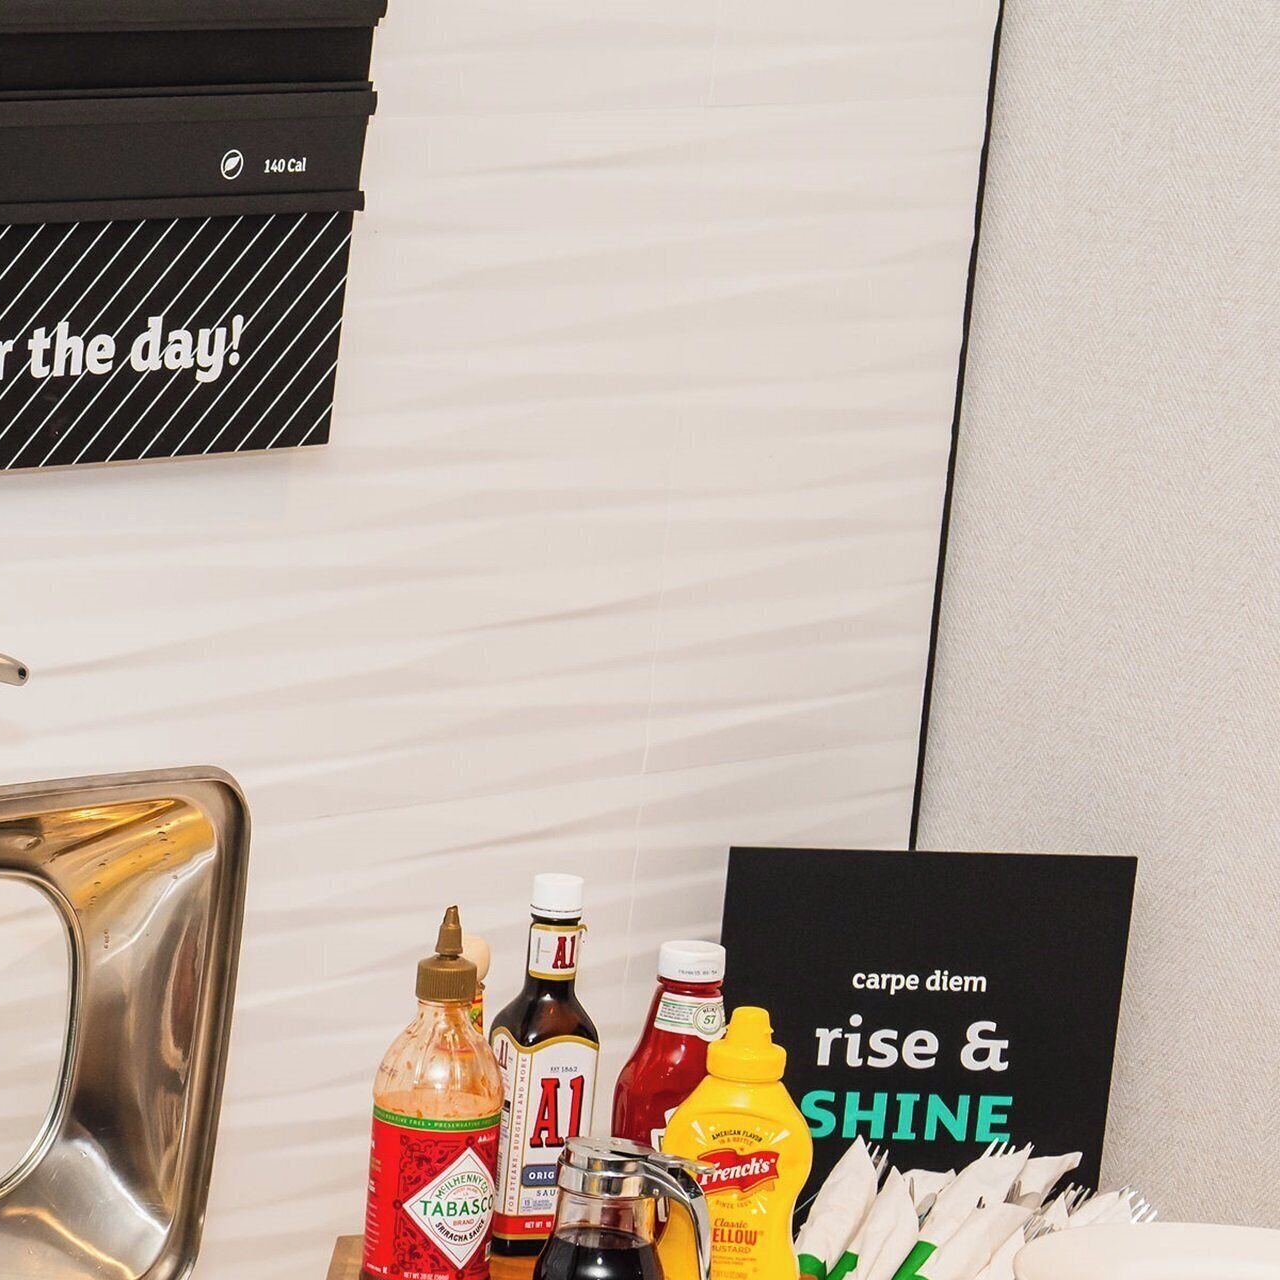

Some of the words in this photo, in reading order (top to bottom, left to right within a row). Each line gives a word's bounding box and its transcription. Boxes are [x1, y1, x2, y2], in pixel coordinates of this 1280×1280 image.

[263, 158, 286, 174] 140
[287, 156, 307, 173] Cal
[26, 321, 116, 379] the
[130, 315, 245, 383] day!
[852, 972, 920, 996] carpe
[925, 969, 987, 993] diem
[703, 1015, 716, 1025] 57
[815, 1013, 939, 1070] rise
[959, 1020, 1009, 1072] &
[800, 1089, 1013, 1144] SHINE
[513, 1107, 522, 1151] BURGERS
[711, 1130, 740, 1140] AMERICAN
[742, 1130, 763, 1143] FLAVOR
[528, 1171, 555, 1180] ORIG
[700, 1157, 770, 1186] French's
[420, 1194, 494, 1217] TABASCO
[435, 1222, 469, 1242] SRIRACHA
[469, 1218, 486, 1240] SAUCE
[452, 1218, 475, 1227] BRAND
[713, 1218, 748, 1229] Classic
[712, 1228, 758, 1246] ELLOW
